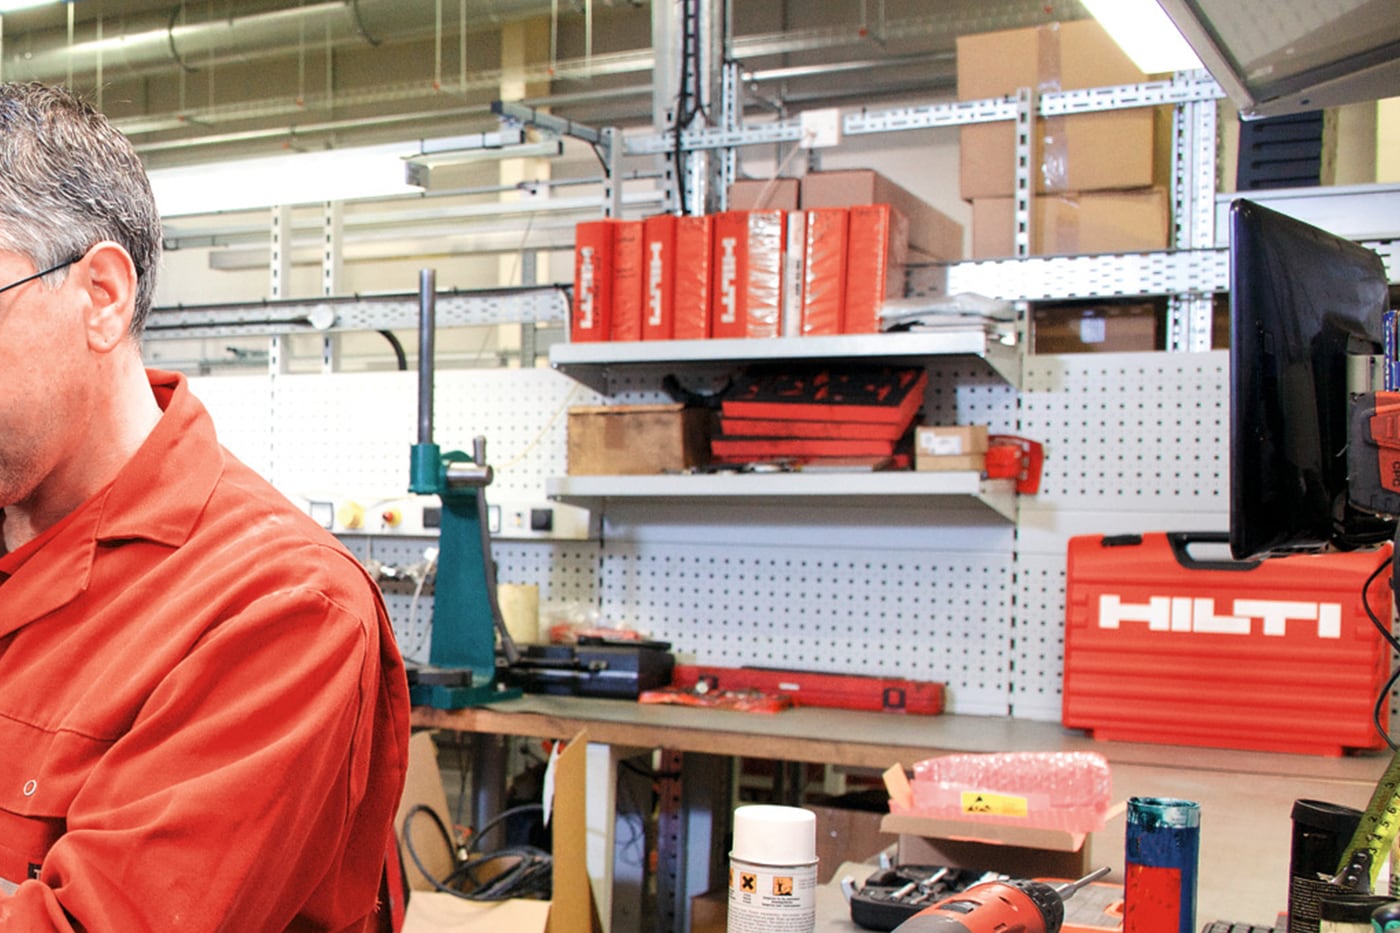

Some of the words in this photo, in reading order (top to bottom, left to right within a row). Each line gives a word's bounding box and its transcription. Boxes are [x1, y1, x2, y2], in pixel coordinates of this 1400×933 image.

[579, 247, 594, 329] HILTI
[649, 242, 663, 326] HILTI
[721, 237, 736, 323] HILTI
[1098, 593, 1342, 639] HILTI
